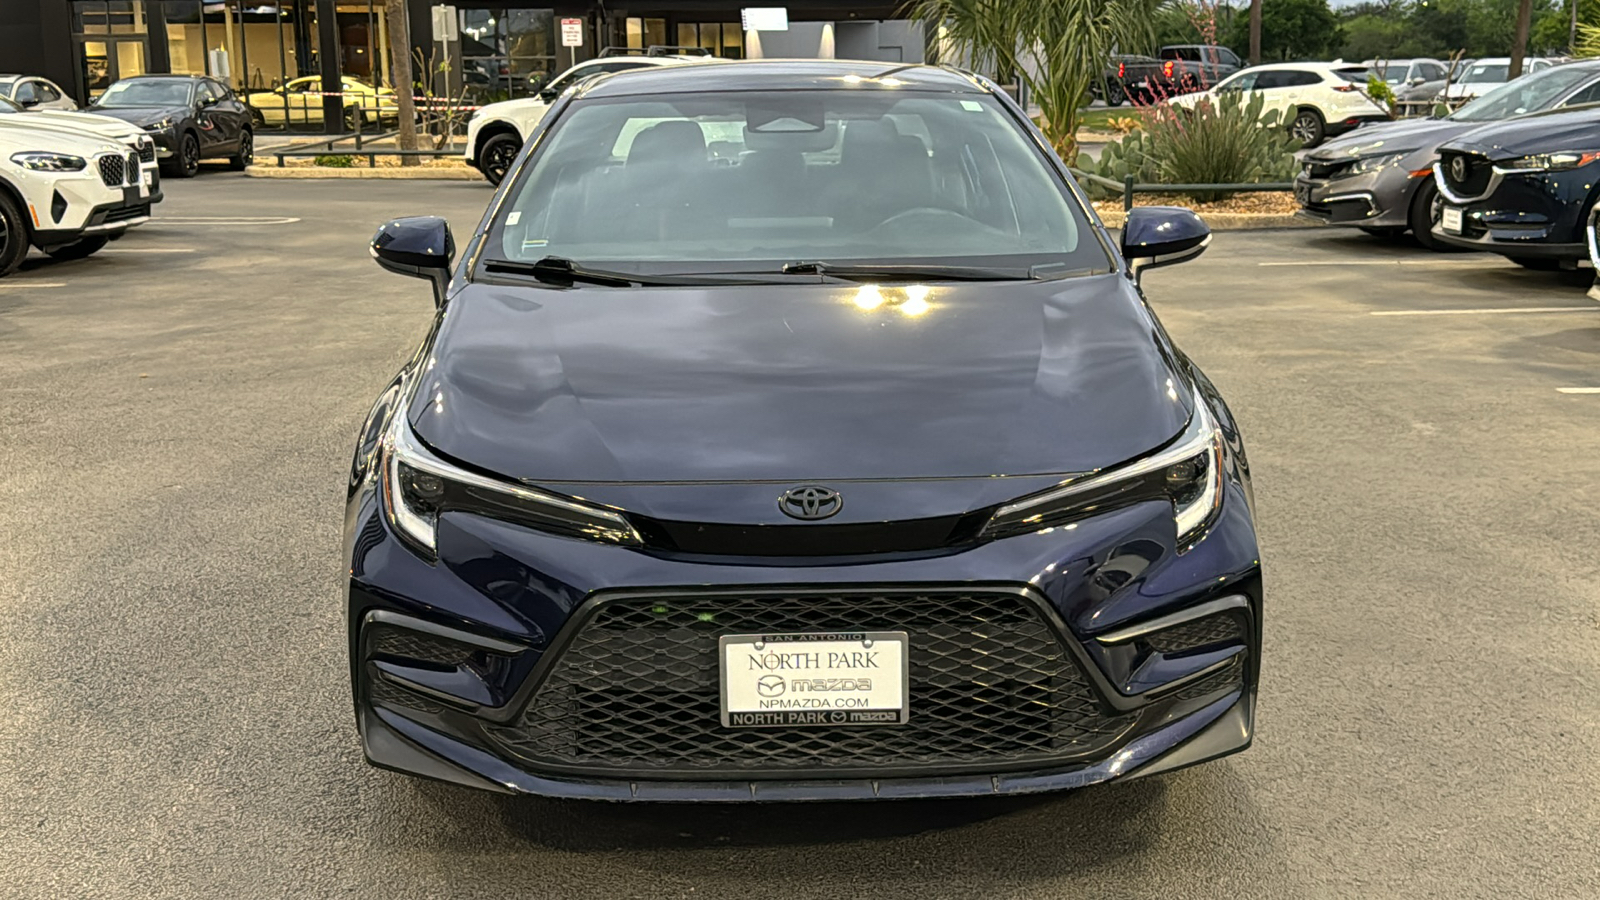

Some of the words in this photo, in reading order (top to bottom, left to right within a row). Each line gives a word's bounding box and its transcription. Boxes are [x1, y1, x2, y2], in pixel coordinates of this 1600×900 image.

[765, 634, 793, 642] SAN
[748, 652, 819, 671] NORTH
[828, 652, 879, 669] PARK
[791, 678, 872, 692] mazda
[759, 698, 868, 709] NPMAZDA.COM
[733, 713, 784, 725] NORTH
[788, 712, 827, 723] PARK
[850, 712, 897, 721] mazda
